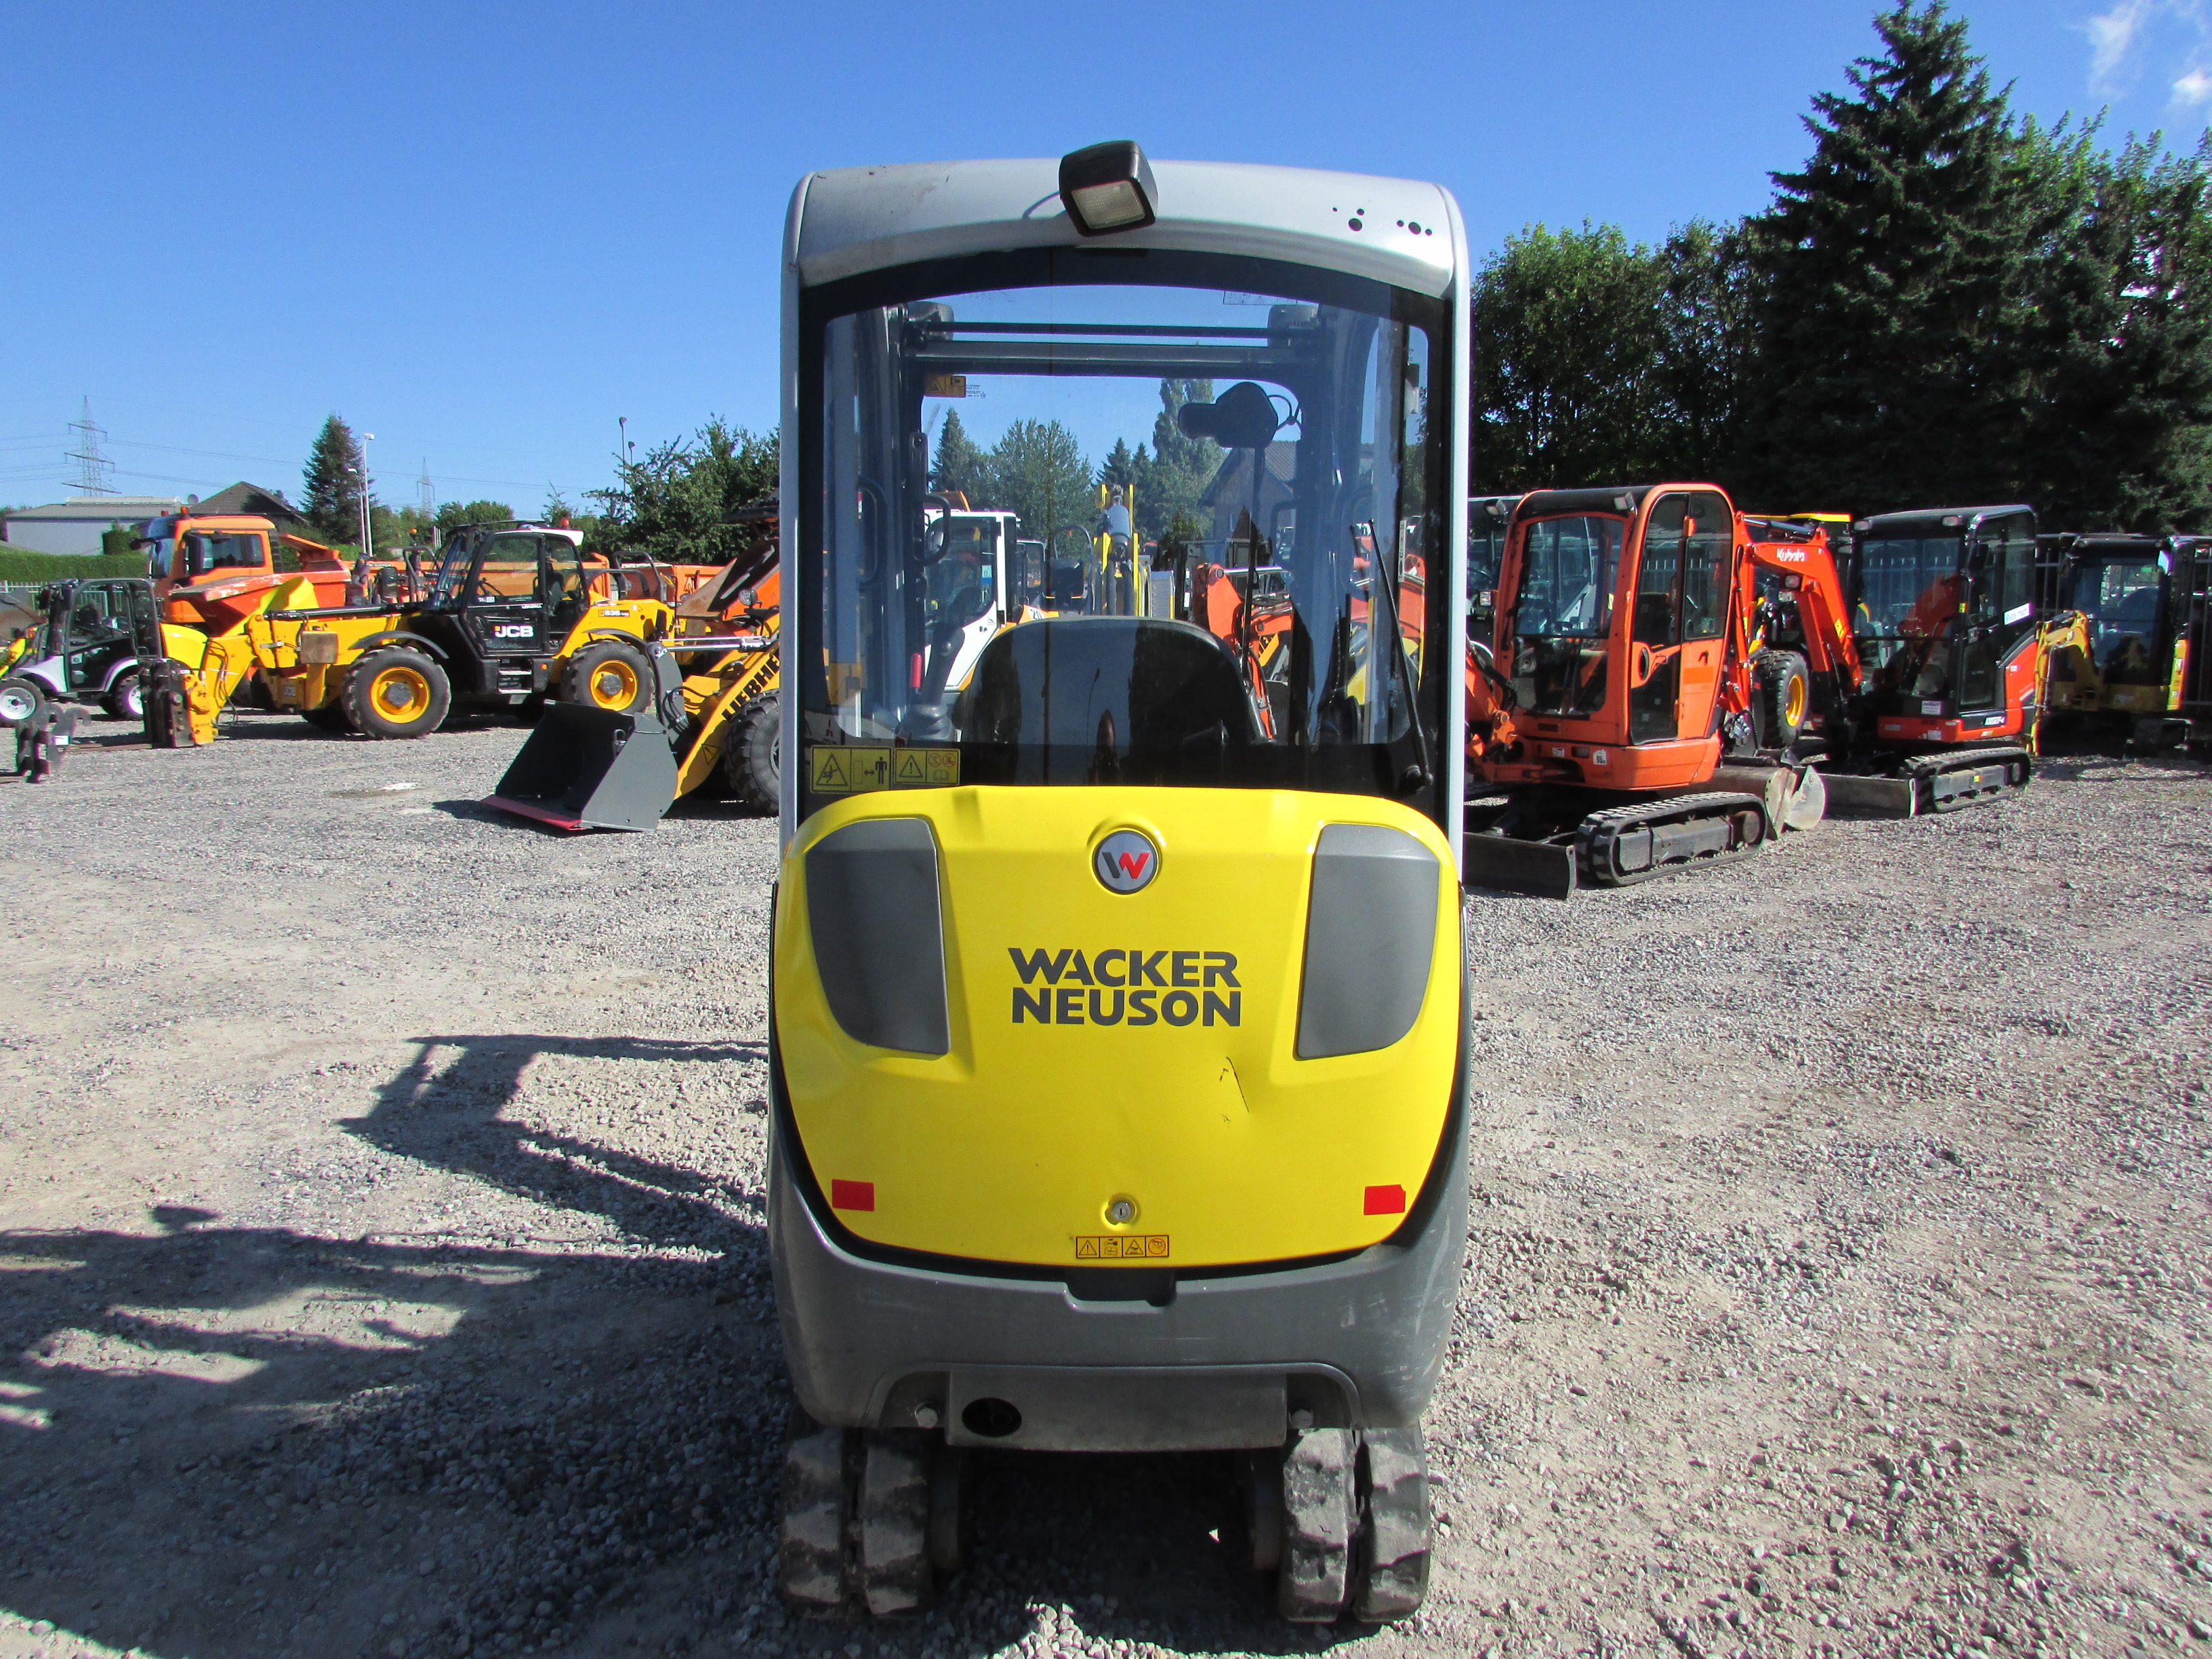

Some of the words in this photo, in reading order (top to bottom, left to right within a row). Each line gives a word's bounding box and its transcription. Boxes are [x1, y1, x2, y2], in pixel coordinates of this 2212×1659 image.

[1776, 548, 1805, 562] Kubota
[495, 625, 534, 638] JCB
[721, 653, 780, 721] LIEBHE
[1007, 947, 1242, 988] WACKER
[1012, 987, 1242, 1027] NEUSON
